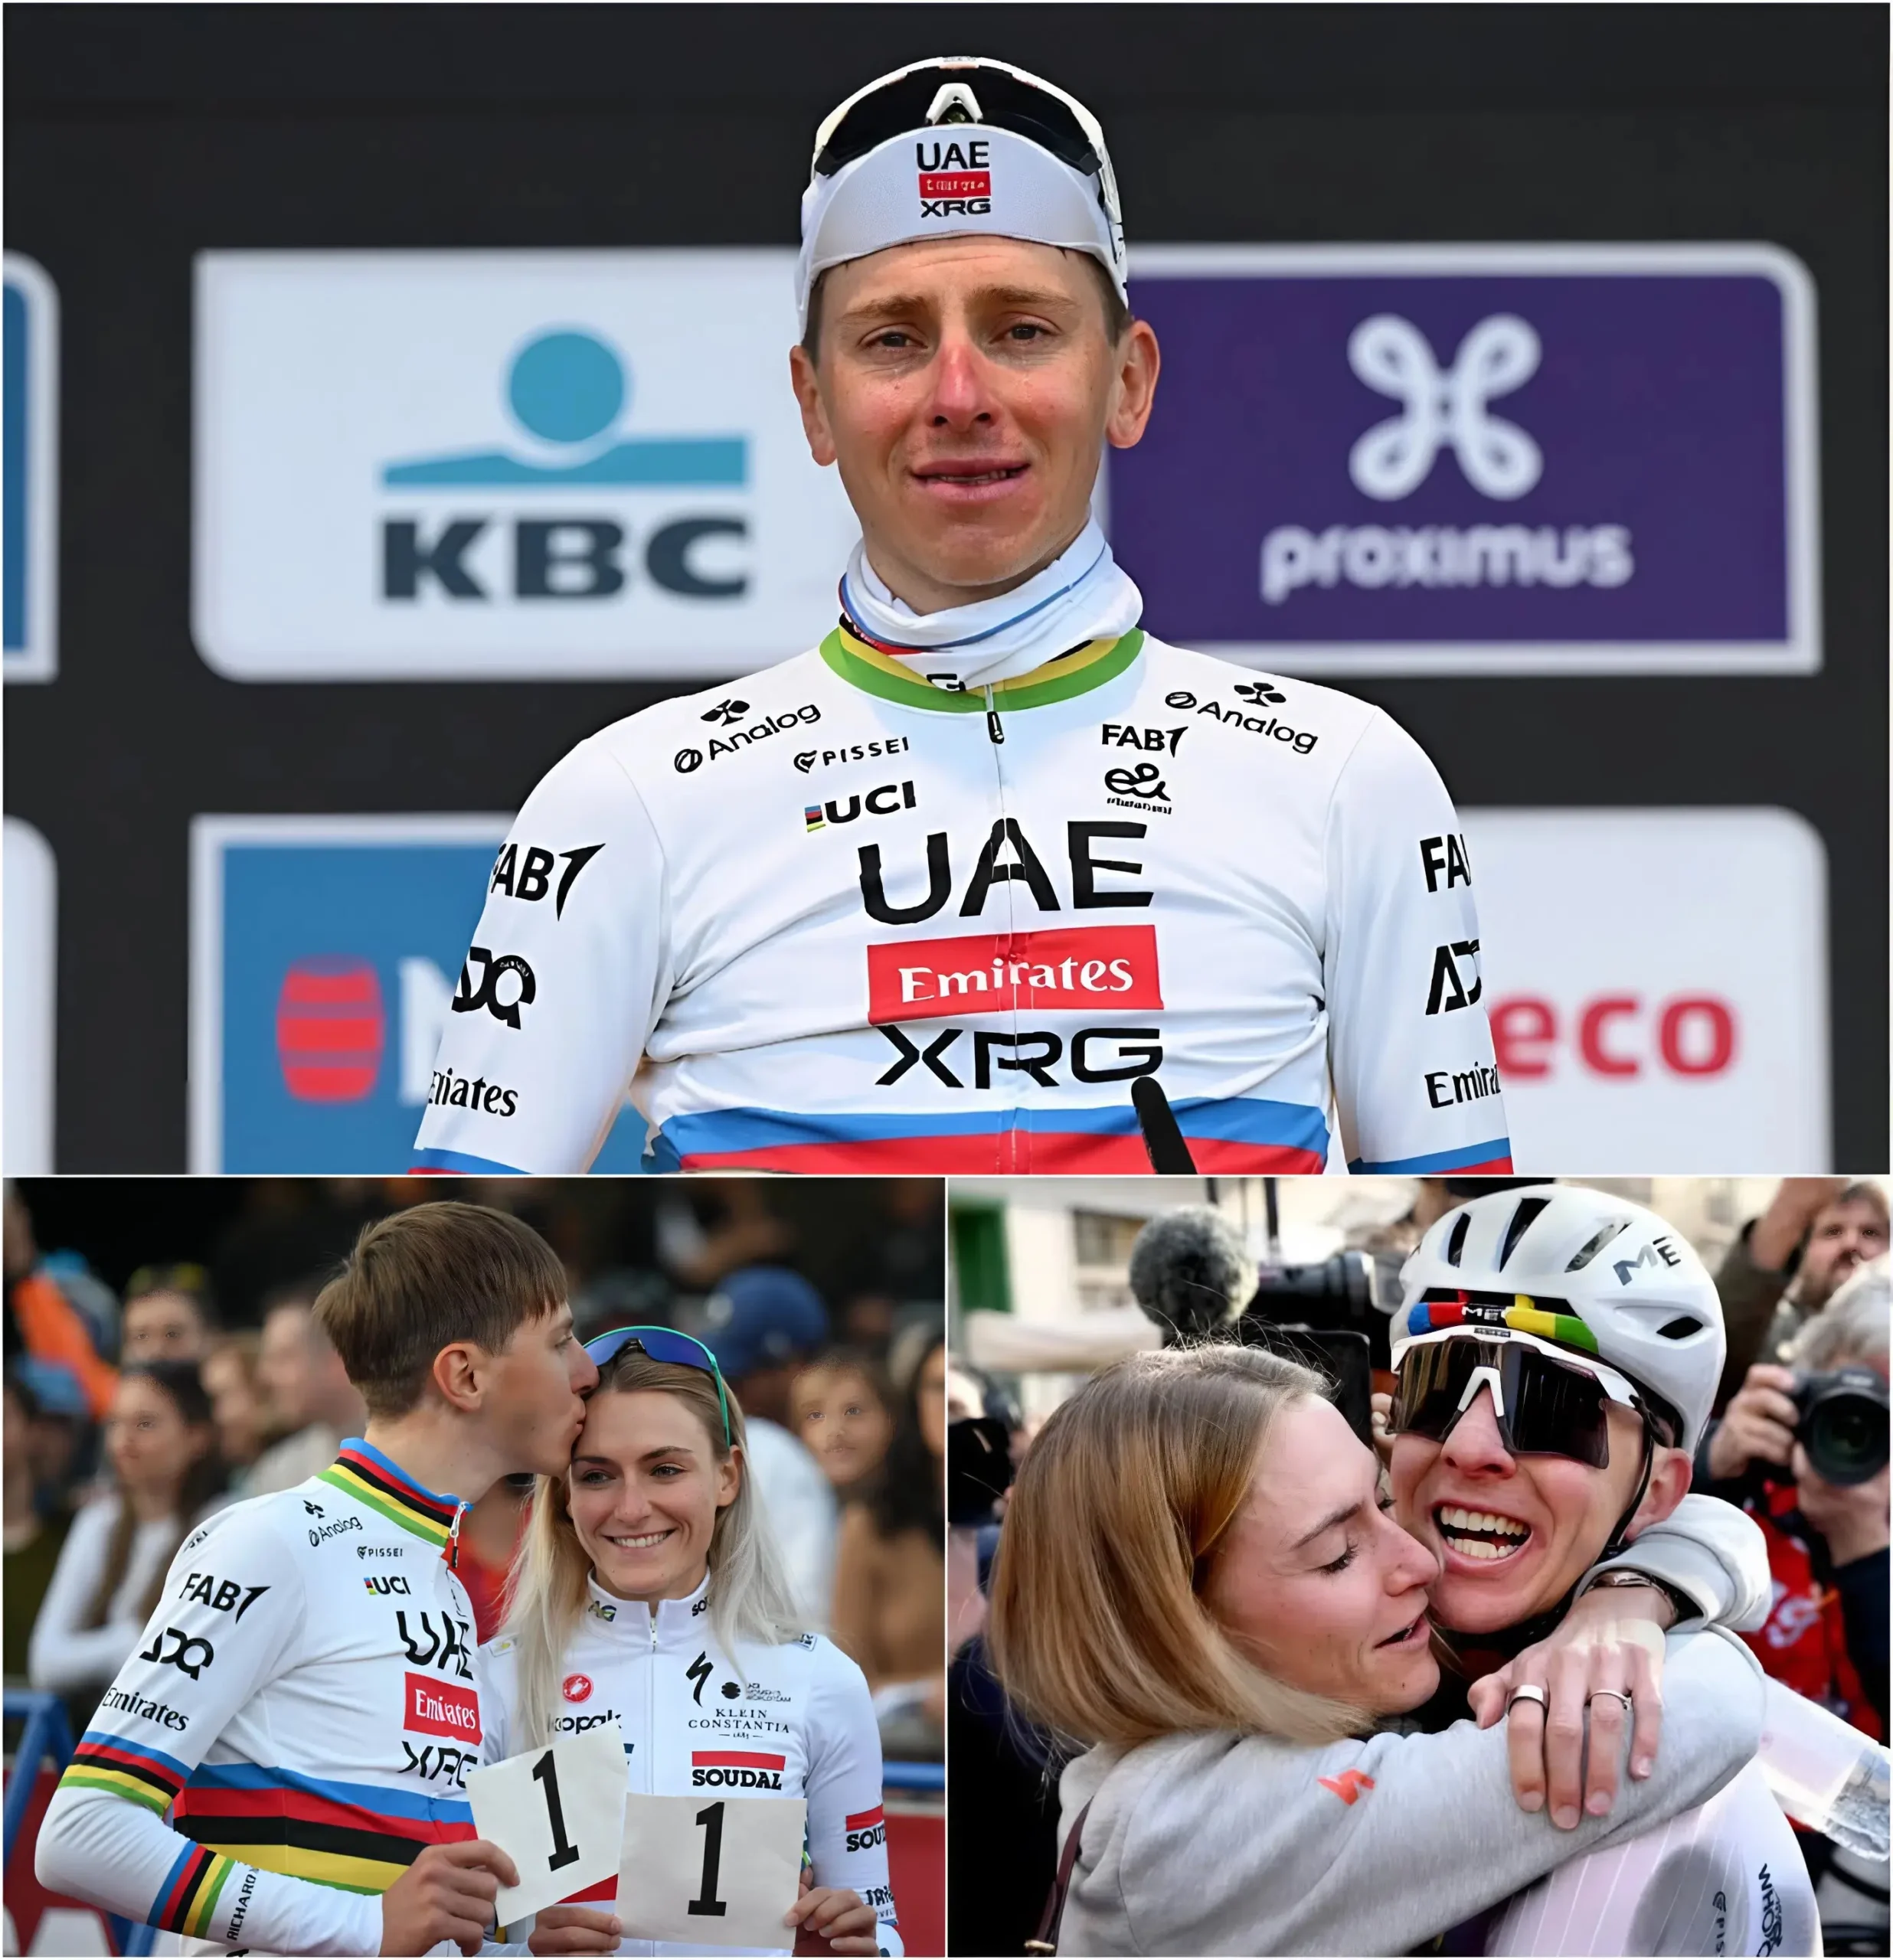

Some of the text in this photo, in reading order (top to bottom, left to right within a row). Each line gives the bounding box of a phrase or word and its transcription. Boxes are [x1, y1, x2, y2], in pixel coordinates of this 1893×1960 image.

[917, 142, 989, 171] UAE
[920, 198, 991, 217] XRG
[381, 515, 750, 602] KBC
[1260, 524, 1634, 603] proximus
[709, 704, 821, 760] Analog
[1198, 701, 1318, 754] Analog
[822, 737, 909, 766] PISSEI
[825, 781, 916, 823] UCI
[858, 818, 1154, 925] UAE
[899, 957, 1133, 1002] Emirates
[875, 1024, 1162, 1089] XRG
[318, 1517, 363, 1541] Analog
[368, 1547, 403, 1557] PISSEI
[372, 1576, 411, 1595] UCI
[395, 1610, 474, 1681] UAE
[102, 1687, 190, 1732] Emirates
[688, 1719, 790, 1733] CONSTANTIA
[716, 1708, 767, 1719] KLEIN
[692, 1769, 782, 1791] SOUDAL
[532, 1749, 580, 1873] 1
[687, 1801, 727, 1917] 1
